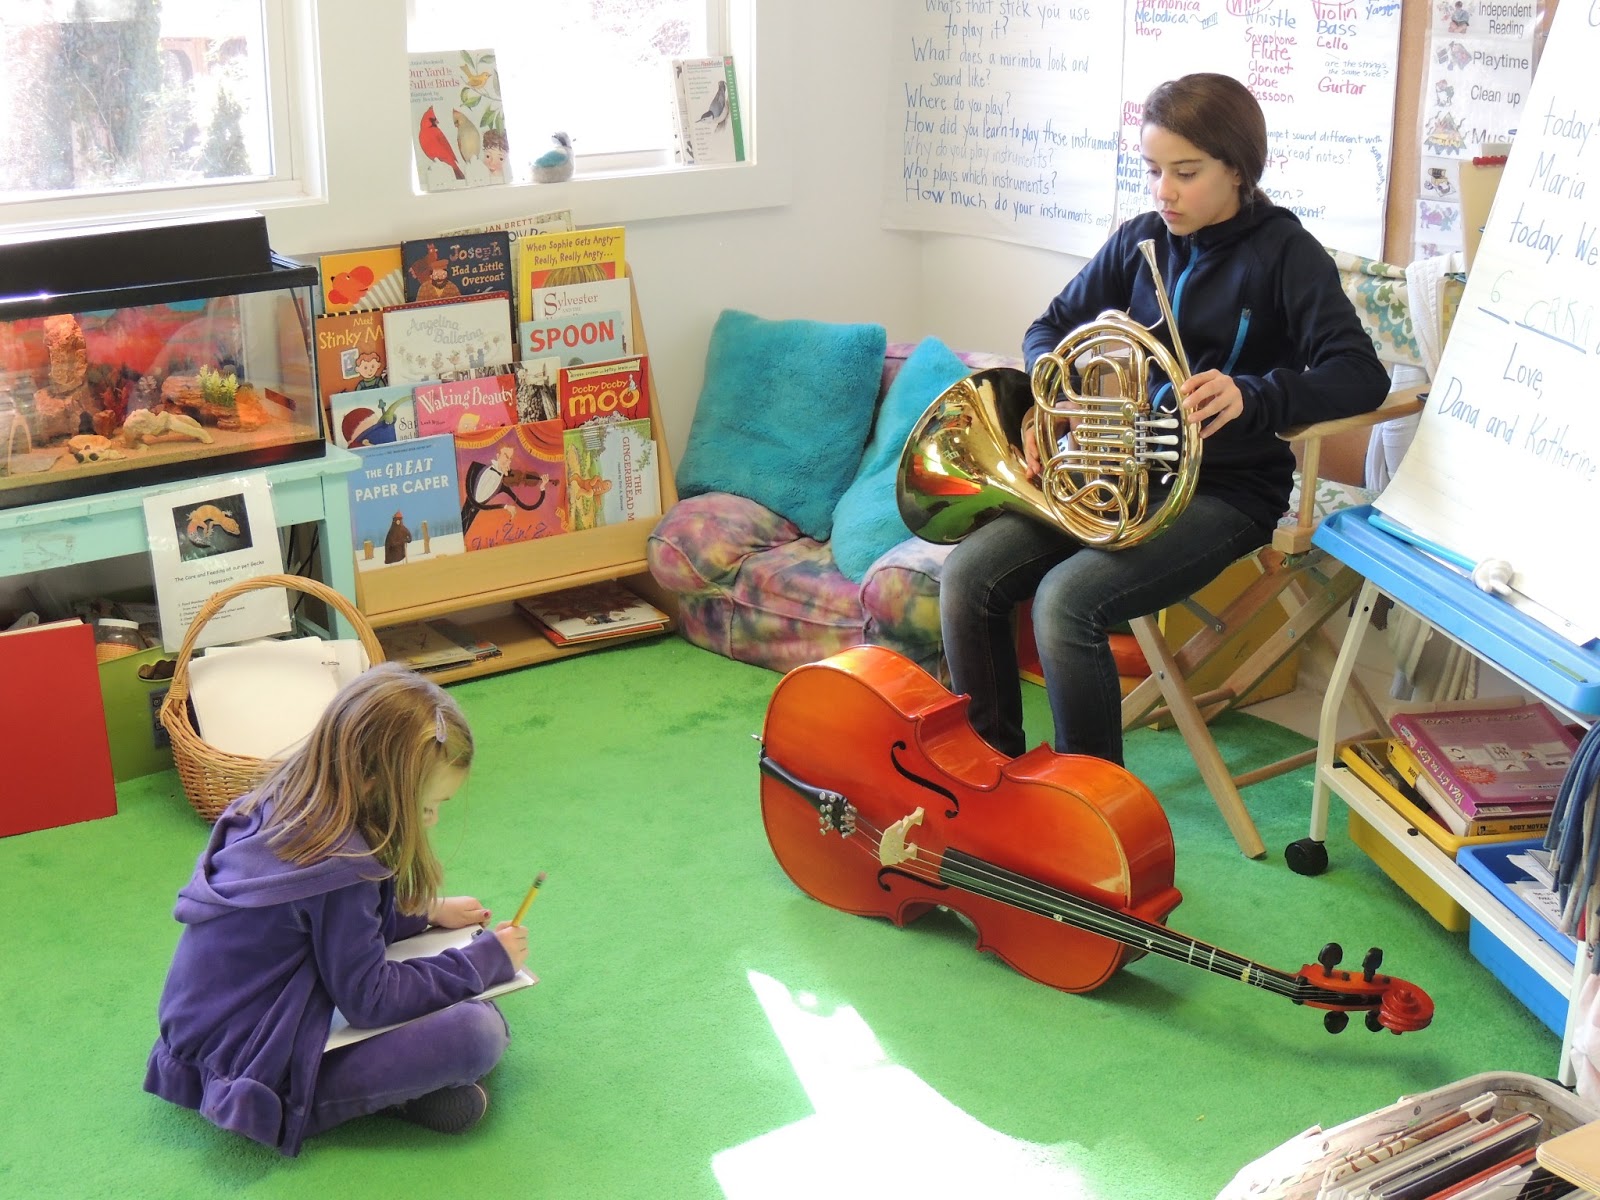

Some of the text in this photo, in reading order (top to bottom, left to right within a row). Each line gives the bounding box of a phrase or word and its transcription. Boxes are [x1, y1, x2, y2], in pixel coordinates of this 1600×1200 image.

[1000, 0, 1032, 17] stick
[1038, 3, 1060, 29] you
[1069, 9, 1090, 21] use
[1134, 7, 1189, 24] Melodica
[1244, 8, 1297, 29] Whistle
[1312, 0, 1358, 20] Violin
[1478, 2, 1532, 18] Independent
[944, 13, 1009, 48] to play it?
[1136, 21, 1162, 42] Harp
[1316, 19, 1358, 37] Bass
[1488, 19, 1524, 38] Reading
[1251, 41, 1292, 61] Flute
[1316, 36, 1349, 51] Cello
[912, 36, 953, 63] What
[959, 49, 982, 65] does
[989, 52, 996, 65] a
[1047, 46, 1068, 72] look
[1072, 56, 1090, 74] and
[1472, 50, 1530, 71] Playtime
[424, 66, 446, 77] Yard
[1248, 60, 1294, 74] Clarinet
[435, 78, 460, 88] Birds
[930, 68, 991, 88] sound like?
[1248, 72, 1278, 88] Oboe
[905, 82, 1012, 124] Where do you play?
[1470, 84, 1521, 108] Clean up
[904, 111, 935, 134] How
[939, 114, 958, 136] did
[963, 123, 979, 146] you
[982, 117, 1007, 139] learn
[1008, 116, 1020, 139] to
[1021, 121, 1040, 148] play
[1042, 118, 1068, 147] these
[904, 132, 931, 164] Why
[936, 139, 950, 157] do
[968, 143, 989, 167] play
[903, 156, 1058, 196] Who plays which instruments?
[1529, 151, 1586, 200] Maria
[904, 178, 945, 202] How
[951, 188, 987, 210] much
[994, 192, 1008, 211] do
[1013, 200, 1035, 222] your
[1040, 203, 1093, 225] instruments
[484, 224, 502, 234] JAN
[504, 218, 534, 230] BRETT
[1508, 202, 1599, 266] today. We
[450, 241, 502, 262] Joseph
[526, 243, 546, 252] When
[548, 239, 572, 252] Sophie
[574, 236, 591, 246] Gets
[560, 251, 581, 263] Really
[451, 264, 470, 277] Had
[478, 261, 504, 273] Little
[462, 272, 506, 287] Overcoat
[544, 292, 598, 317] Sylvester
[352, 316, 374, 328] Meet
[406, 314, 460, 336] Angelina
[318, 328, 362, 350] Stinky
[433, 328, 484, 344] Ballerina
[530, 319, 615, 353] SPOON
[1503, 342, 1544, 400] Love,
[572, 379, 628, 395] Dooby Dooby
[418, 386, 514, 414] Waking Beauty
[1438, 376, 1480, 429] Dana
[1486, 414, 1520, 446] and
[365, 457, 434, 480] THE GREAT
[622, 436, 634, 510] GINGERBREAD
[354, 474, 449, 502] PAPER CAPER
[634, 474, 642, 496] THE
